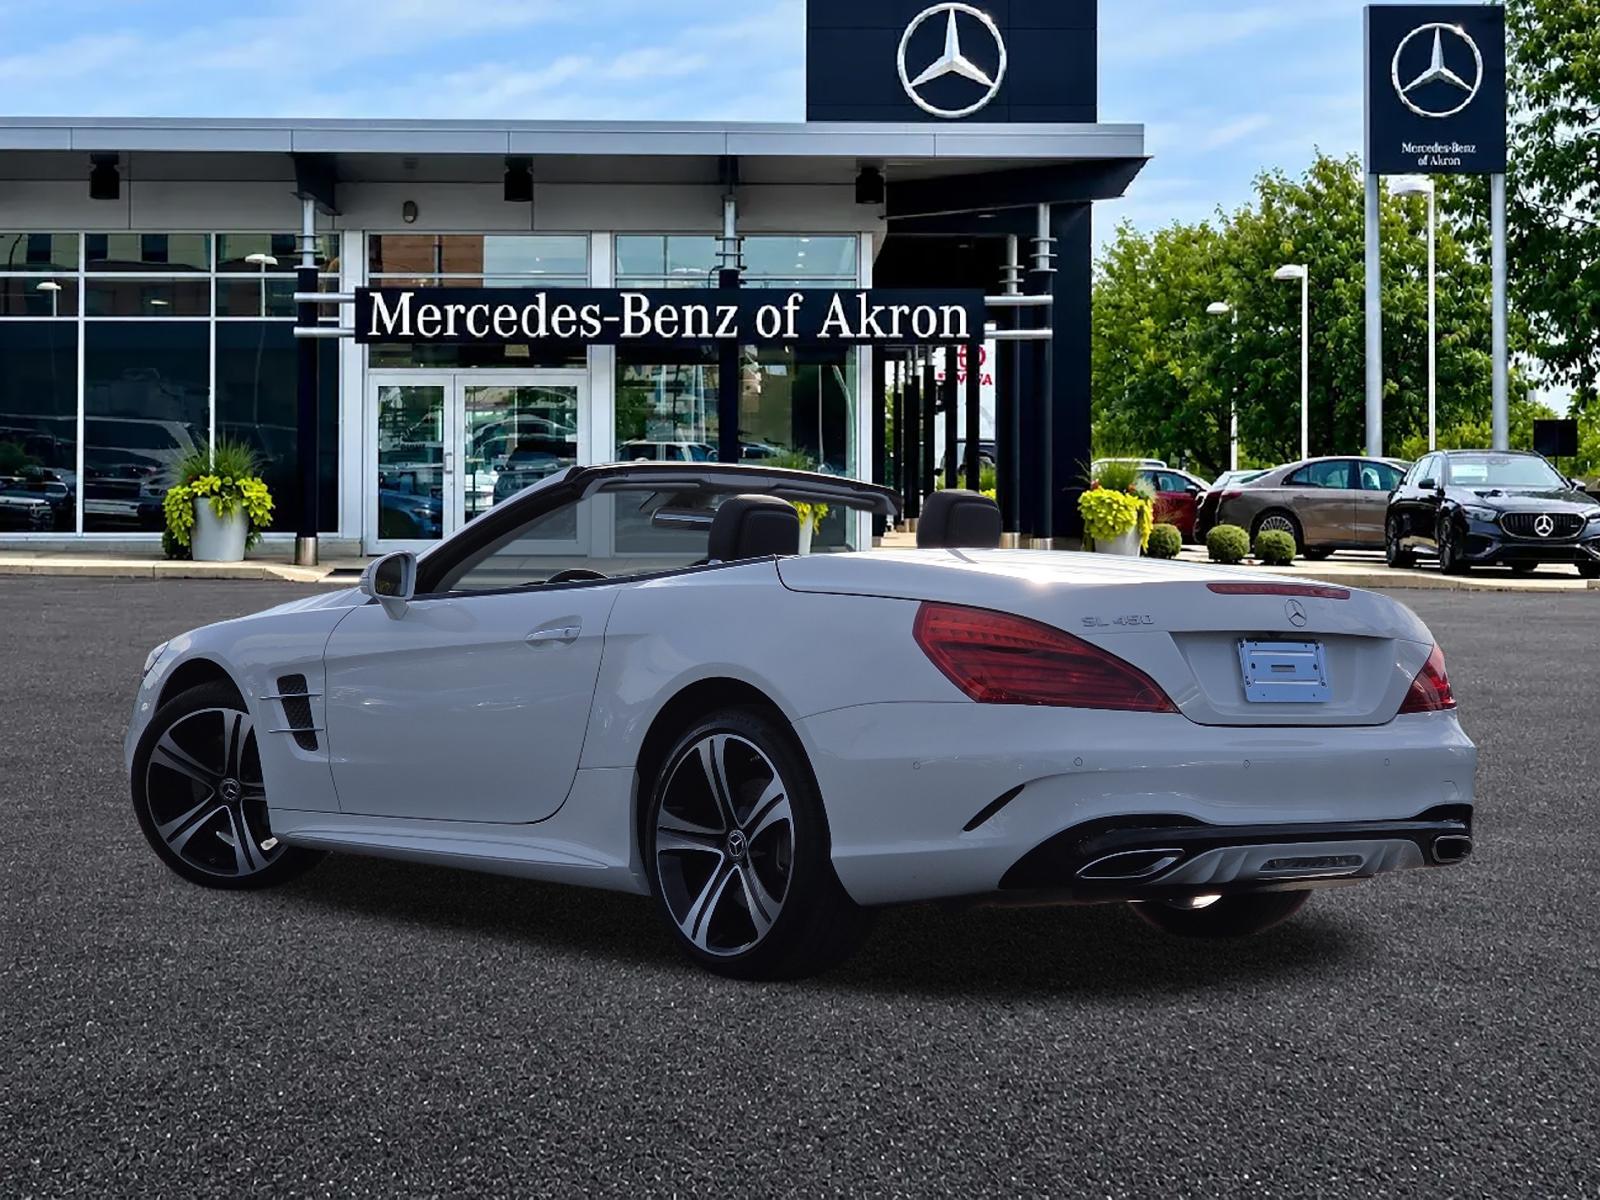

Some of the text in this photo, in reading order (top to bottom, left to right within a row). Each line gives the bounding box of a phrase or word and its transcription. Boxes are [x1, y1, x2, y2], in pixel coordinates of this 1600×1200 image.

[1401, 141, 1477, 154] Mercedes-Benz
[1417, 154, 1461, 166] of Akron
[367, 291, 970, 339] Mercedes-Benz of Akron
[1081, 613, 1155, 628] SL 450
